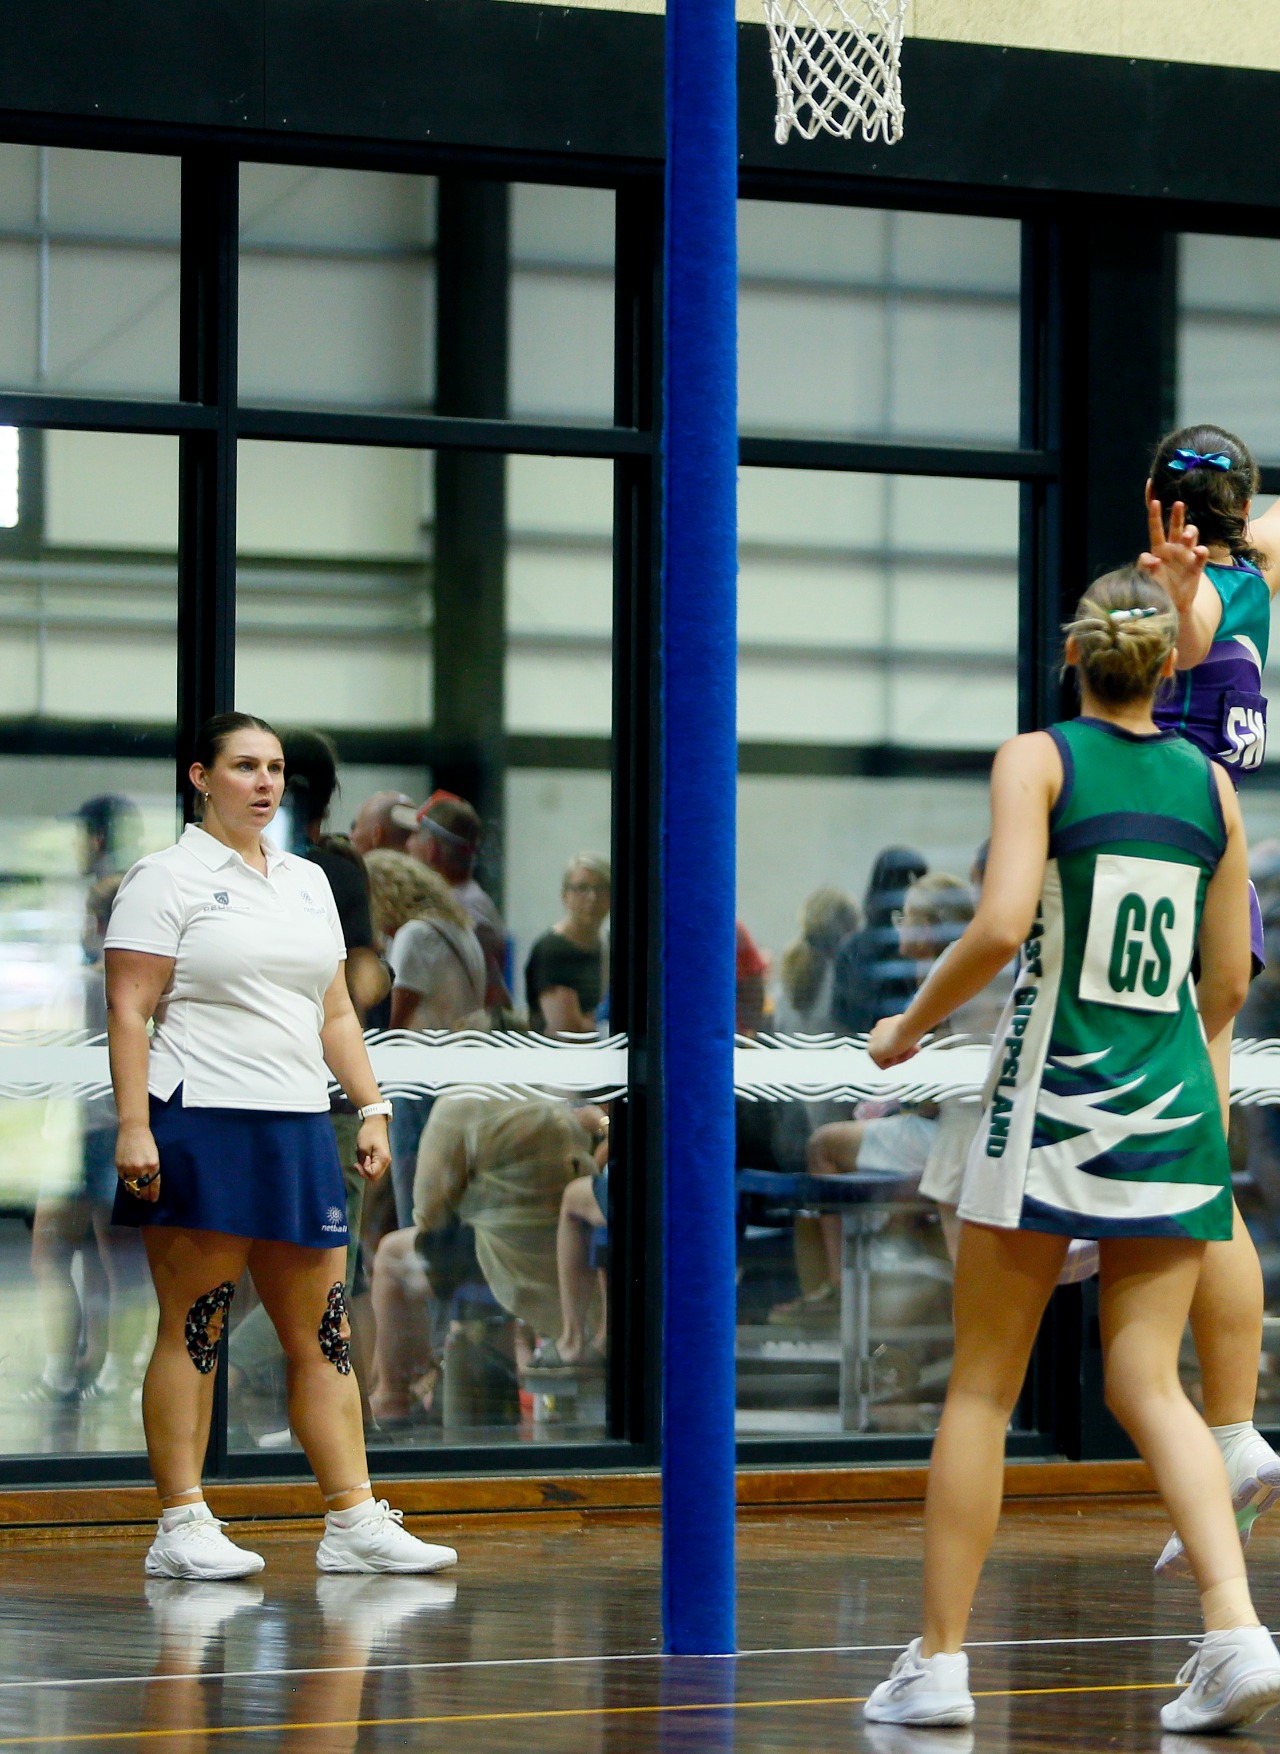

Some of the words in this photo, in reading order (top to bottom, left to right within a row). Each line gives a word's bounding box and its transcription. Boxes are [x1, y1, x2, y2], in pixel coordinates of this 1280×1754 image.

[1107, 891, 1176, 997] GS
[986, 986, 1038, 1158] GIPPSLAND
[321, 1224, 348, 1233] netball
